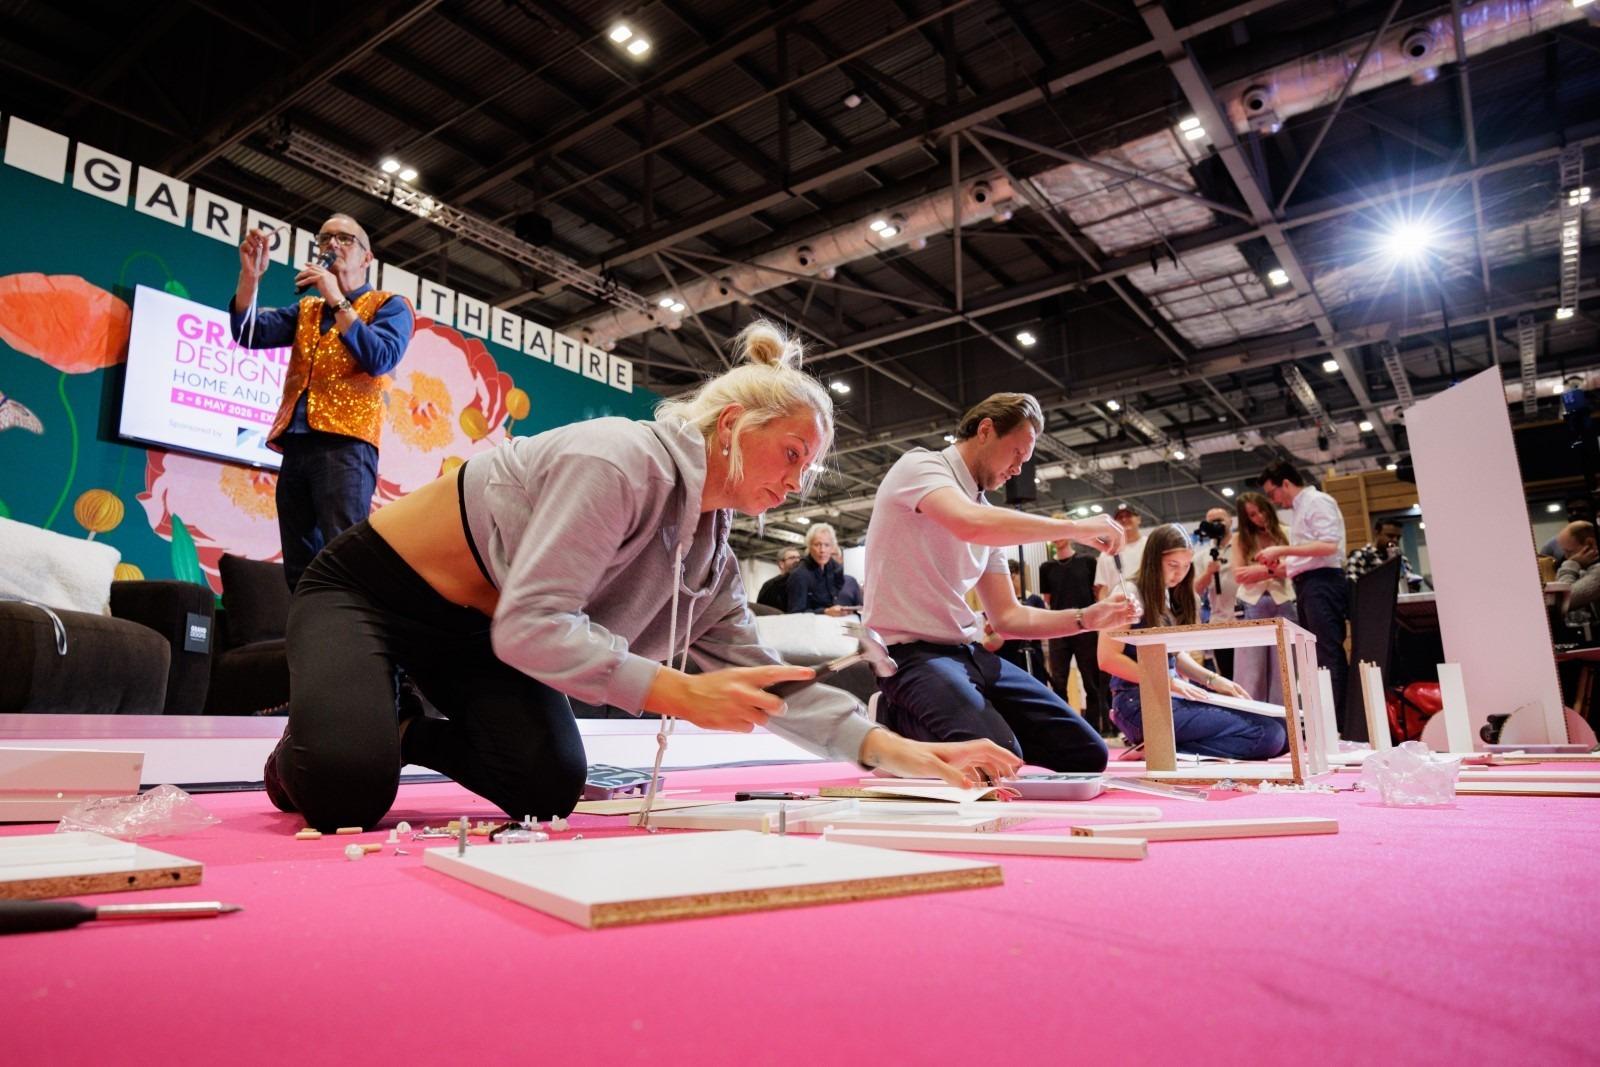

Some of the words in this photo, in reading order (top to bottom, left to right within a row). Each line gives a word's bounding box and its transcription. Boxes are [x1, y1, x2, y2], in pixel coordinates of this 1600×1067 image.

[84, 157, 370, 284] GARDE
[431, 289, 627, 385] THEATRE
[176, 340, 285, 389] DESIGN
[173, 369, 227, 394] HOME
[233, 385, 270, 404] AND
[177, 392, 185, 402] 2
[203, 398, 227, 411] MAY
[259, 412, 276, 423] EX
